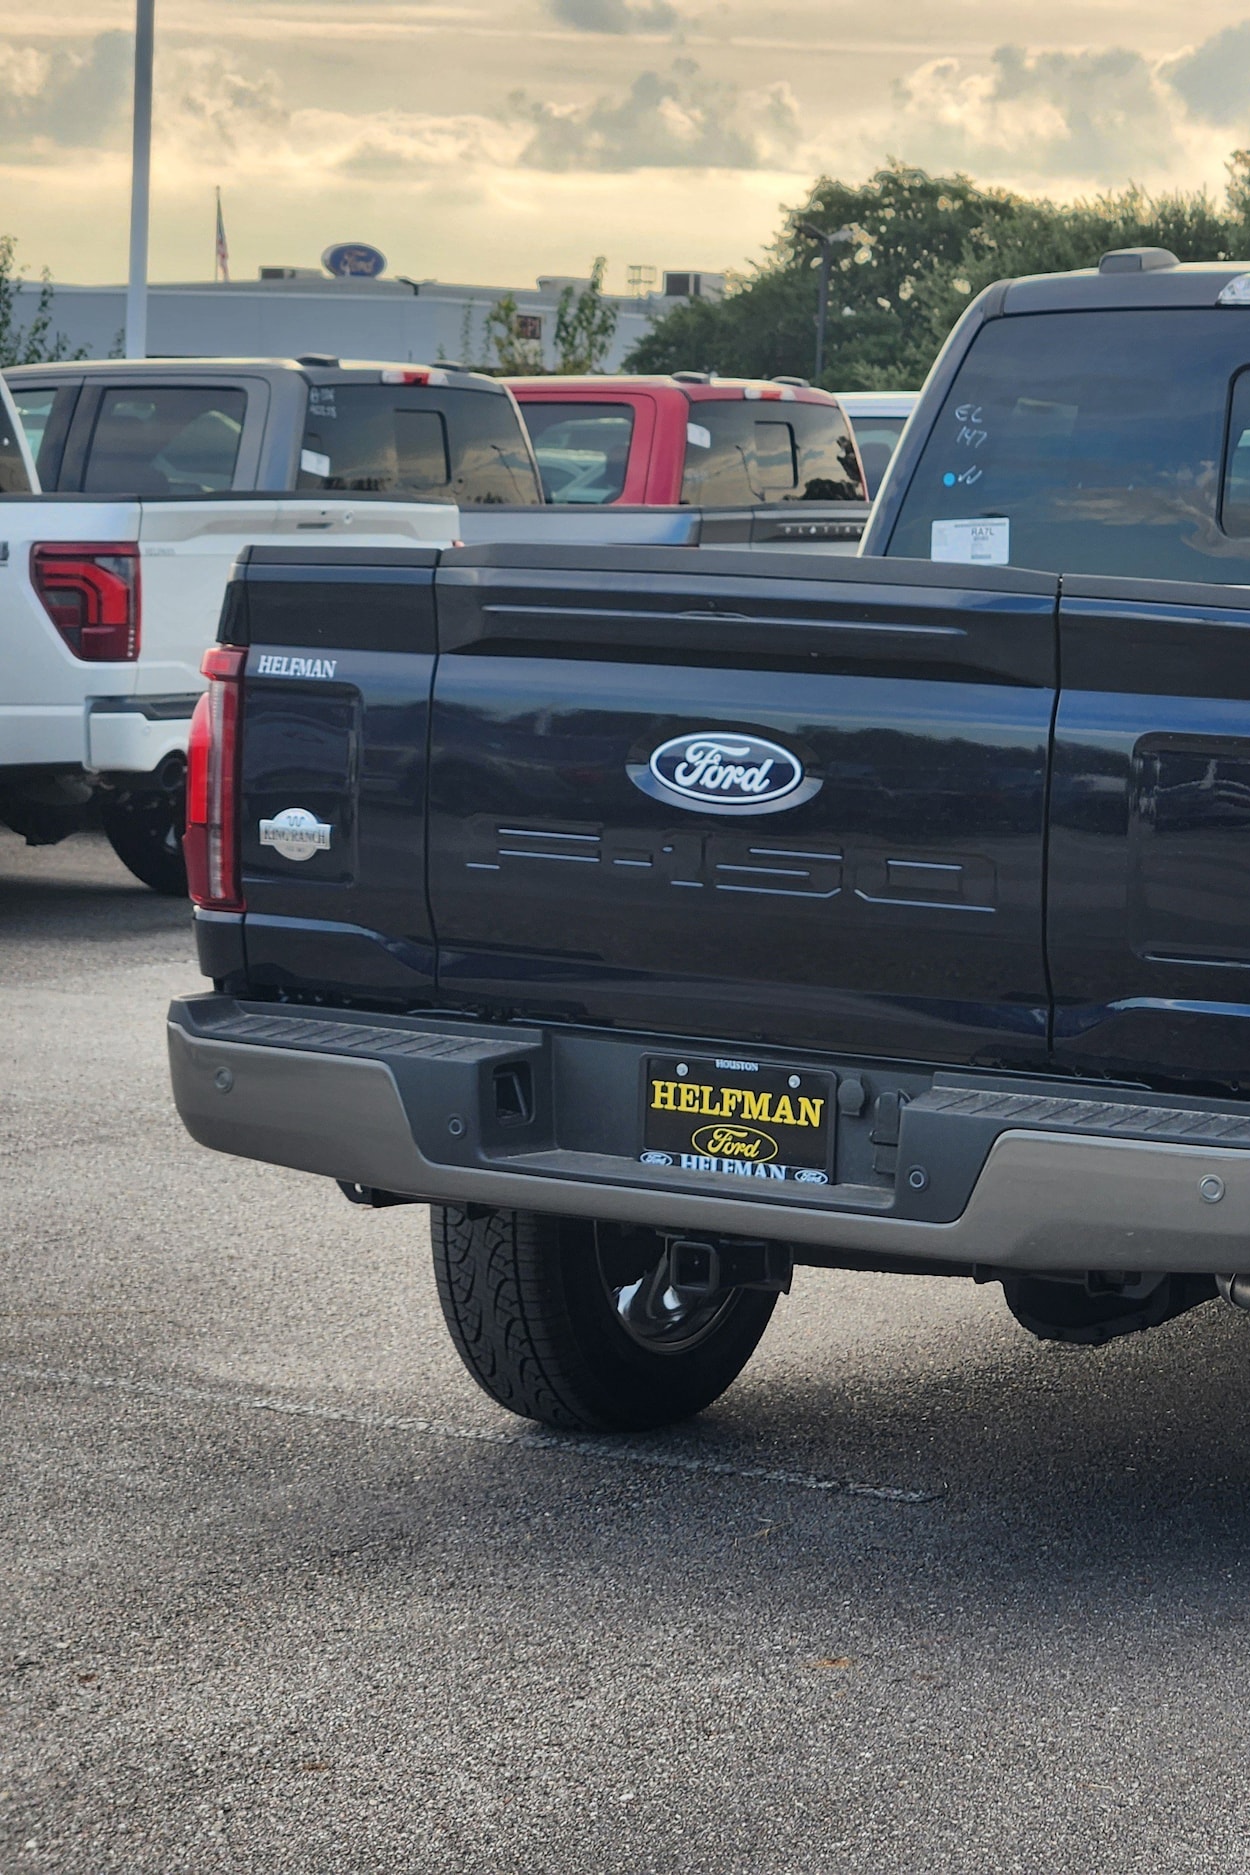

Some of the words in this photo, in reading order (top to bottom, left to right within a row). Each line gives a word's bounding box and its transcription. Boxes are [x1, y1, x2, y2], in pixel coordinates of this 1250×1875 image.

[957, 425, 987, 448] 147
[258, 655, 338, 678] HELFMAN
[674, 741, 774, 793] Ford
[715, 1059, 759, 1071] HOUSTON
[650, 1079, 824, 1128] HELFMAN
[706, 1127, 762, 1158] Ford
